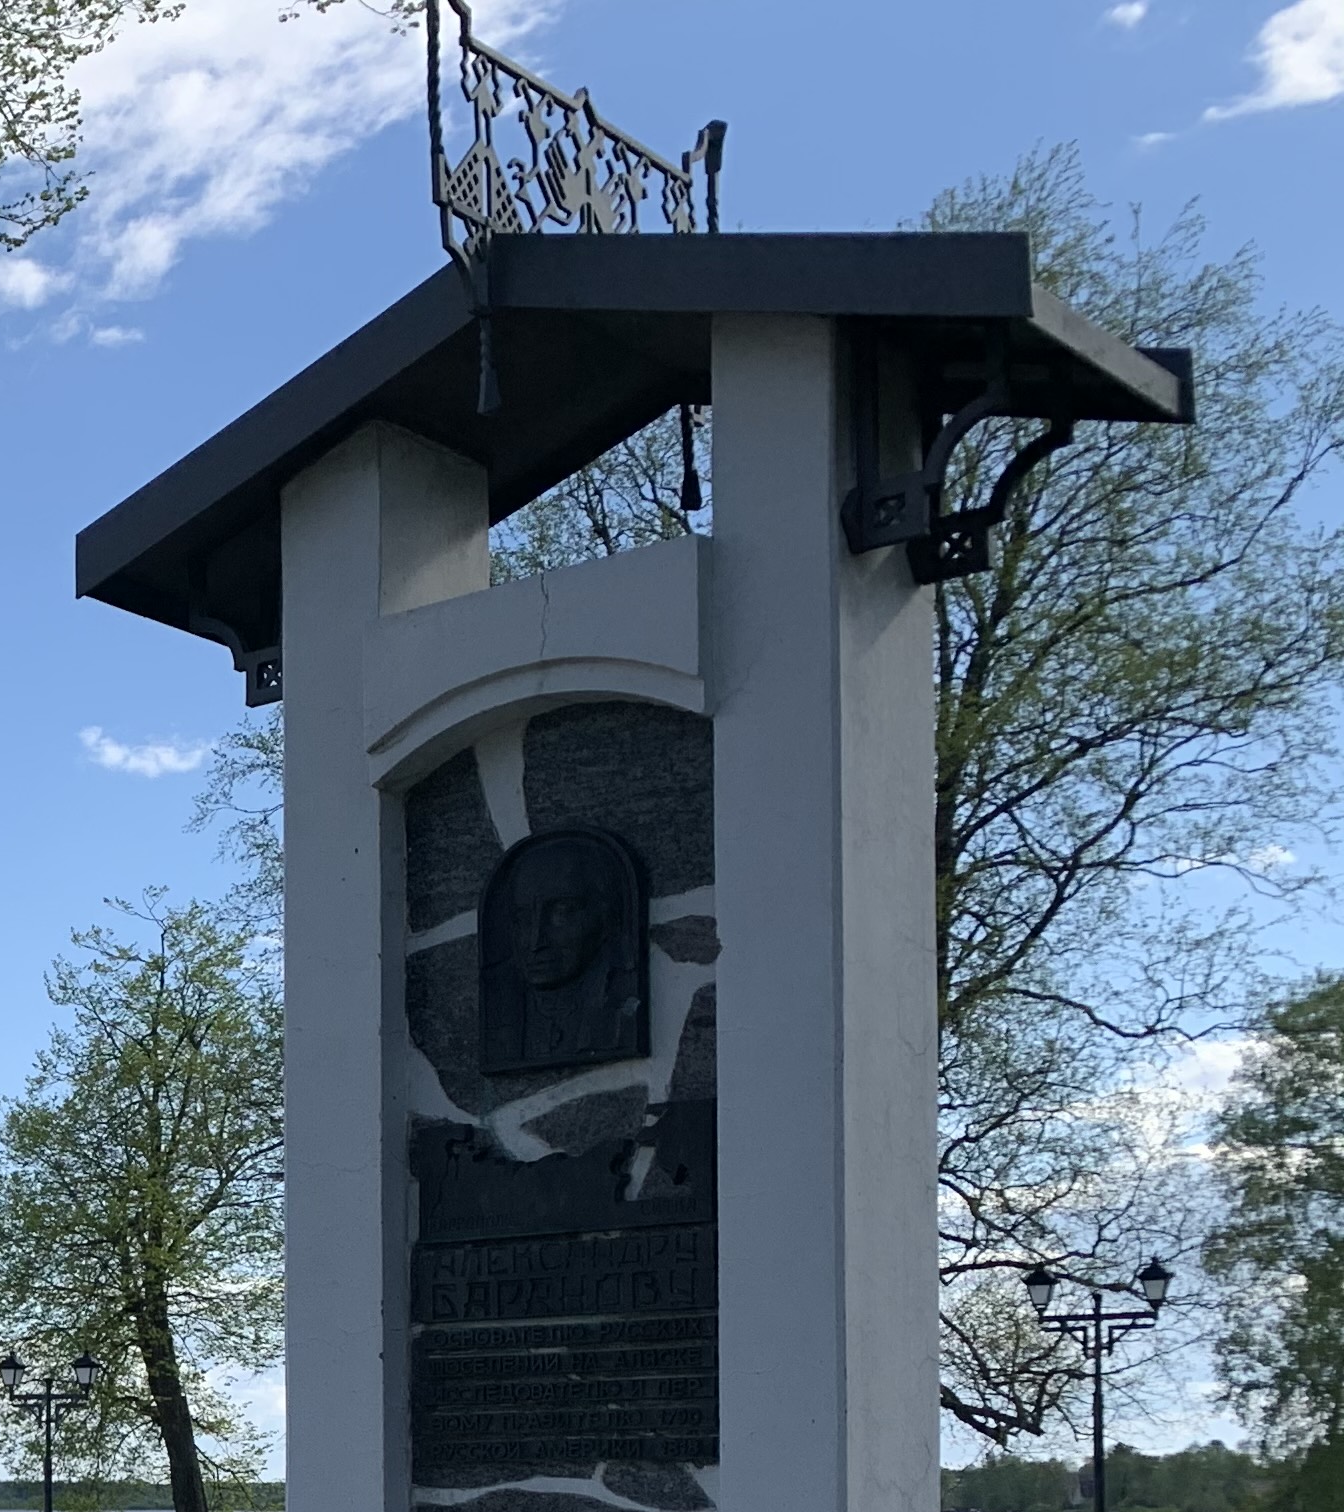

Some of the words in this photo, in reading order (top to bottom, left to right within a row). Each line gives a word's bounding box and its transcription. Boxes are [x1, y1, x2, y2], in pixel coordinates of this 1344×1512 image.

[433, 1230, 699, 1278] АЛЕКСАНДРУ
[432, 1266, 698, 1320] БАРАНОВУ
[432, 1324, 586, 1347] ОСНОВАТЕЛЮ
[600, 1319, 702, 1340] РУССКИХ
[572, 1351, 597, 1370] НА
[614, 1347, 703, 1368] АЛЯСКЕ
[433, 1381, 623, 1404] ИССЛЕДОВАТЕЛЮ
[631, 1381, 645, 1397] И
[431, 1414, 493, 1432] ВОМУ
[503, 1409, 644, 1430] ПРАВИТЕЛЮ
[537, 1438, 643, 1459] АМЕРИКИ
